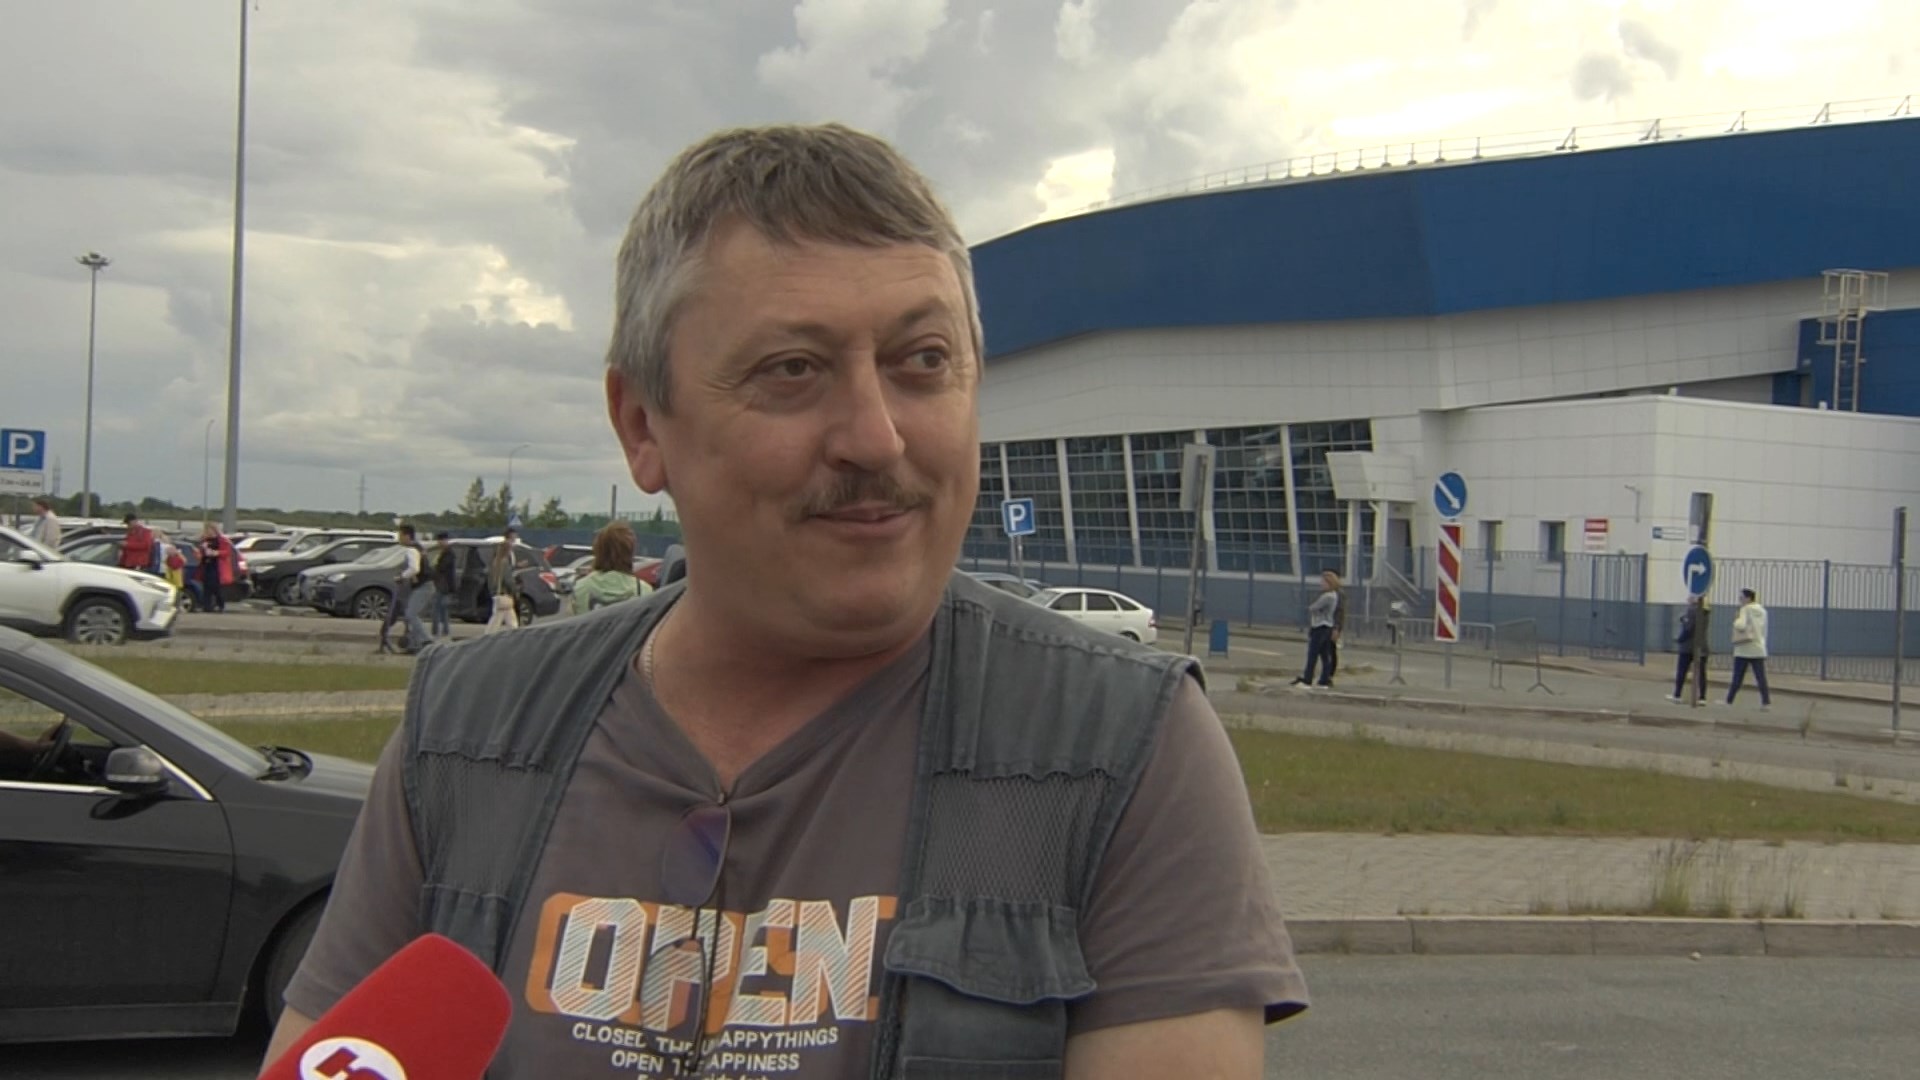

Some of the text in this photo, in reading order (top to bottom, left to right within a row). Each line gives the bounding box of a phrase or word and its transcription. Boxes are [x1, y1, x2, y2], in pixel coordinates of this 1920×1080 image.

[8, 432, 35, 466] P
[1008, 503, 1026, 531] P
[548, 894, 880, 1032] OPEN
[611, 1049, 664, 1073] OPEN
[704, 1052, 800, 1072] APPINESS
